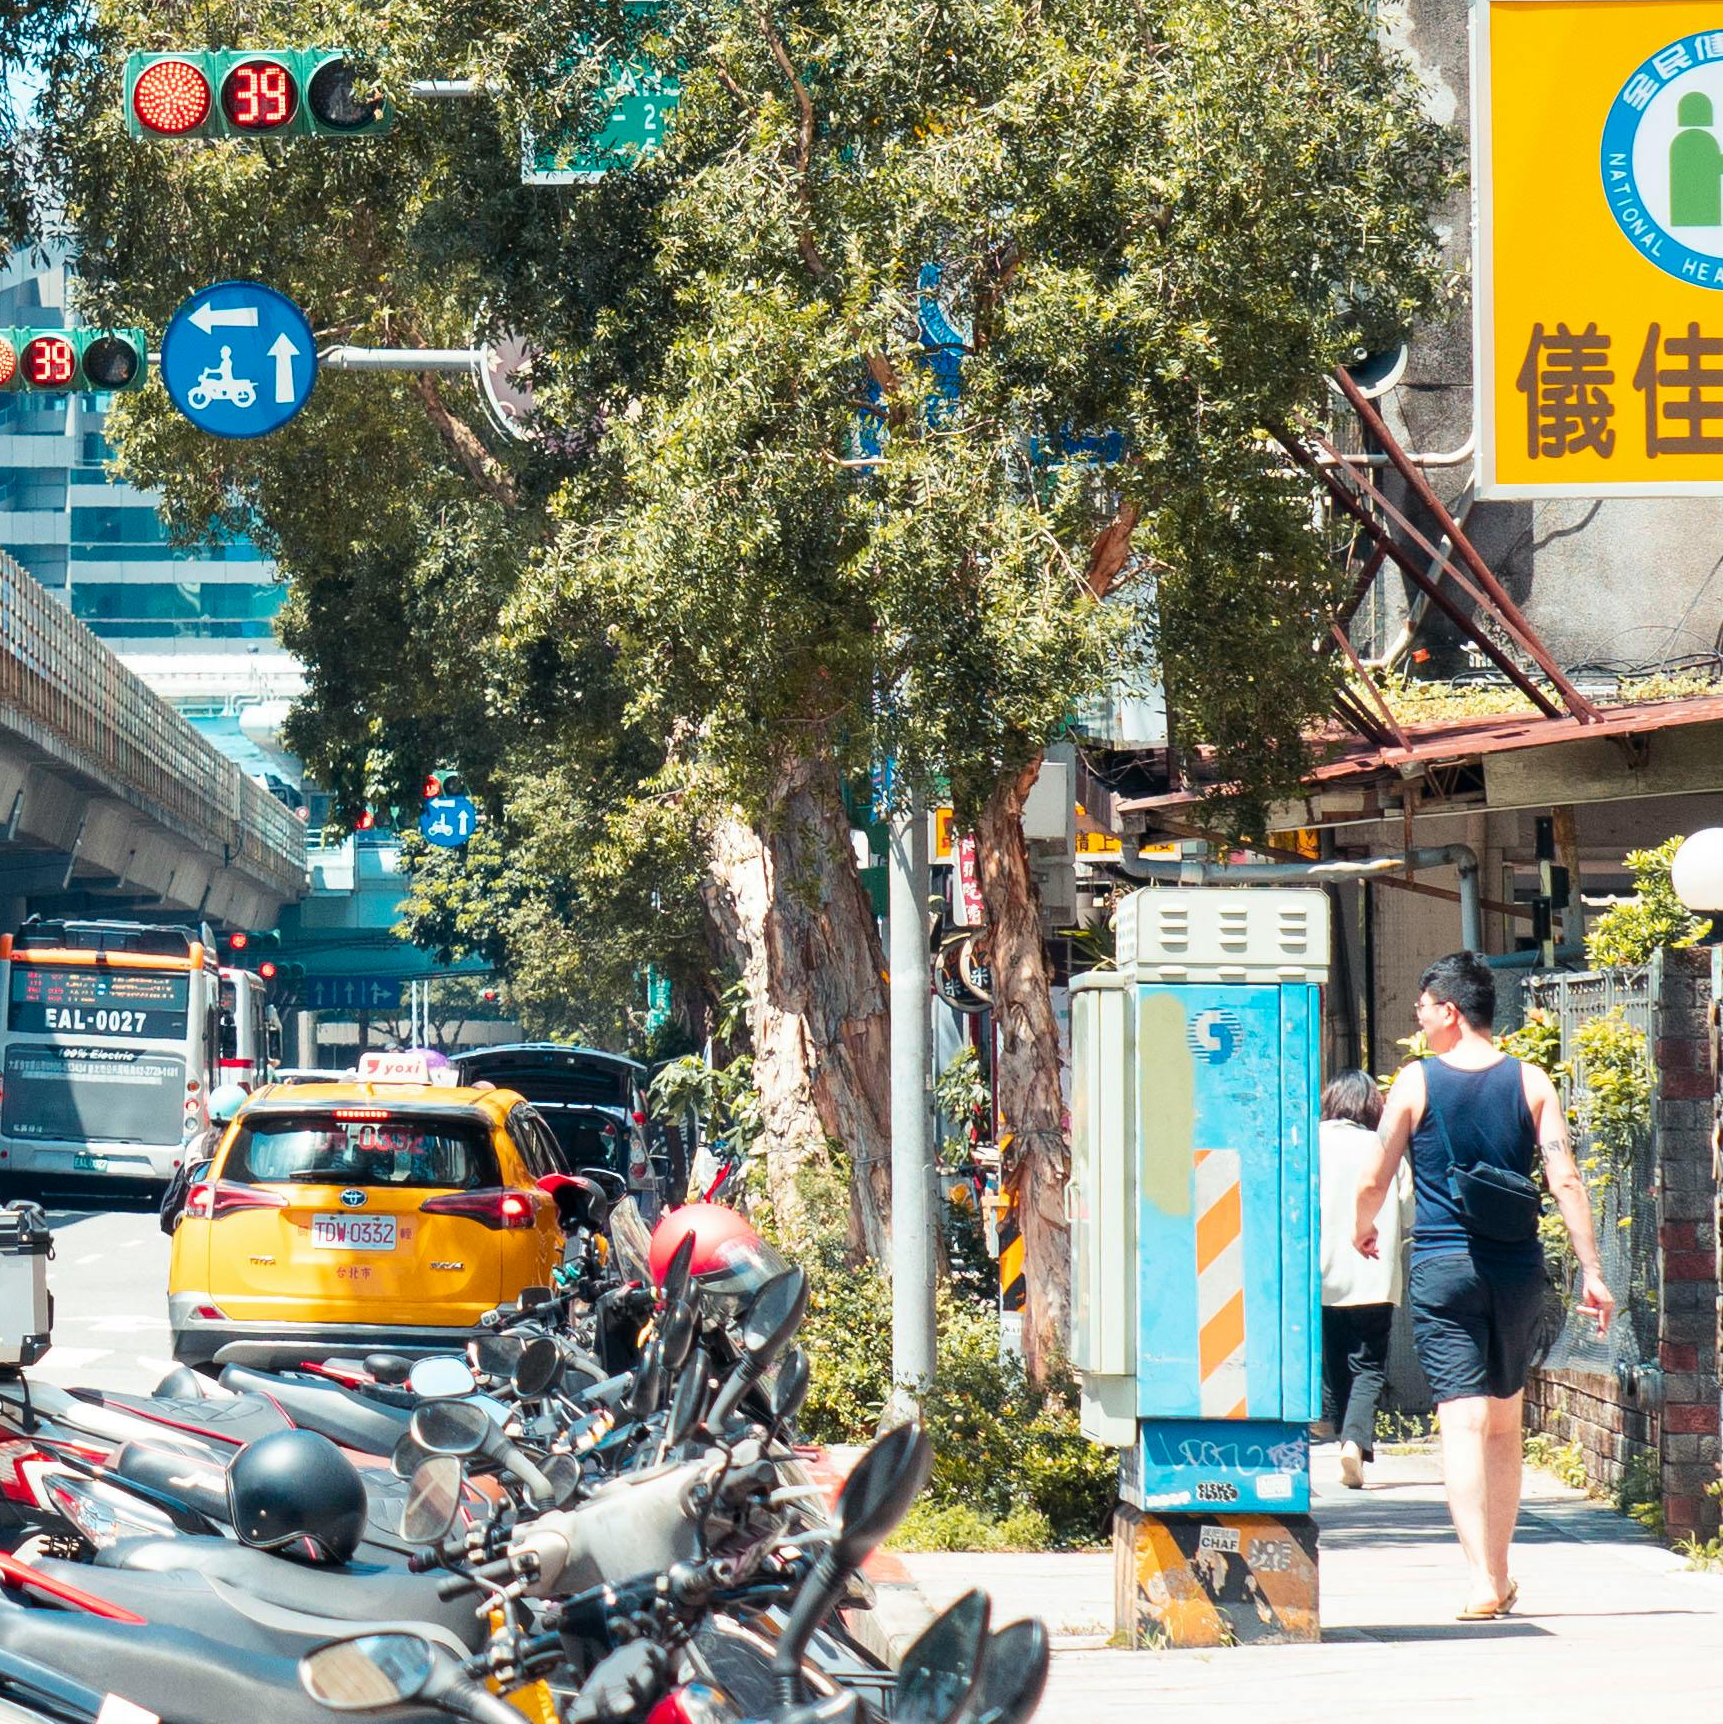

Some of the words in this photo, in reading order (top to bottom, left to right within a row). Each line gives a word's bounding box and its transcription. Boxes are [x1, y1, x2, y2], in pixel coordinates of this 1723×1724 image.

[235, 67, 286, 123] 39
[1609, 152, 1663, 257] NATIONAL
[35, 340, 71, 382] 39
[1515, 321, 1723, 460] 儀佳
[45, 1007, 147, 1033] EAL-0027
[89, 1049, 135, 1061] Electric
[383, 1060, 422, 1076] yoxi
[314, 1221, 395, 1245] TDW-0332
[336, 1267, 373, 1280] 台北市
[1201, 1537, 1238, 1550] CHAF
